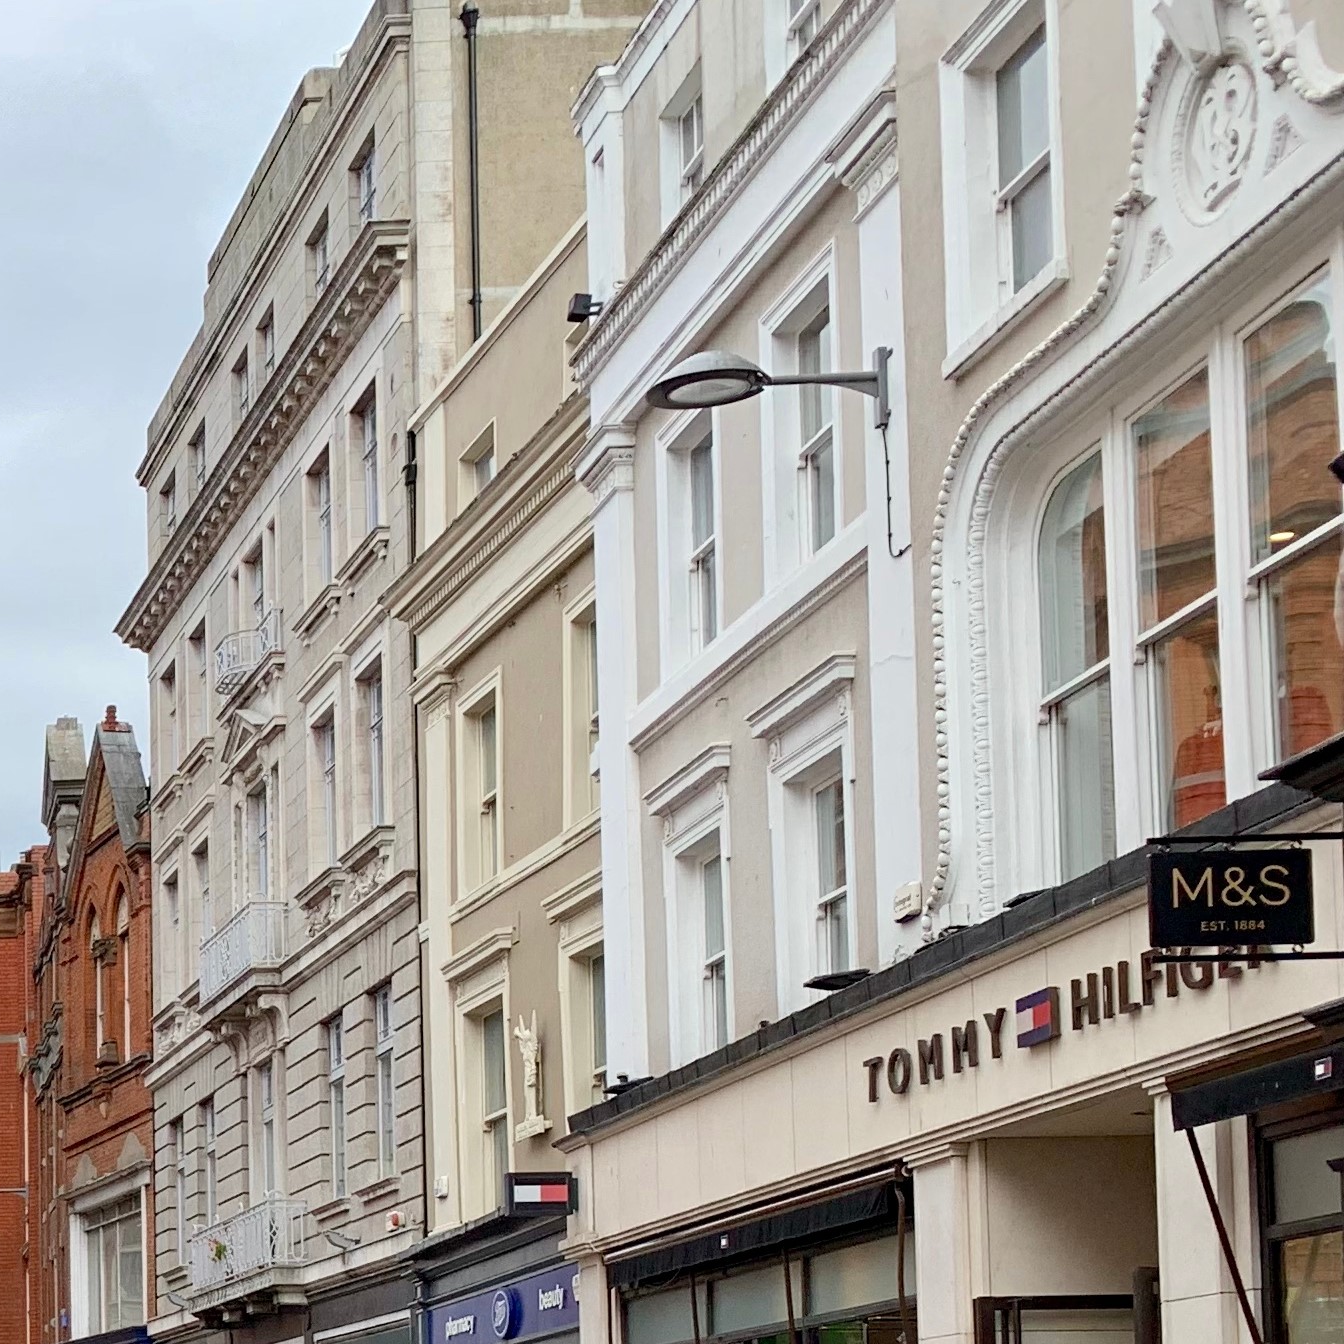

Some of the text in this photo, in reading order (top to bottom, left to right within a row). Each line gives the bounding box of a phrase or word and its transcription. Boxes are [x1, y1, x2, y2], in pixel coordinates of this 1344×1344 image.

[1172, 865, 1291, 908] M&S
[1200, 920, 1266, 931] EST. 1884
[863, 1007, 1007, 1103] TOMMY
[538, 1283, 564, 1310] beauty
